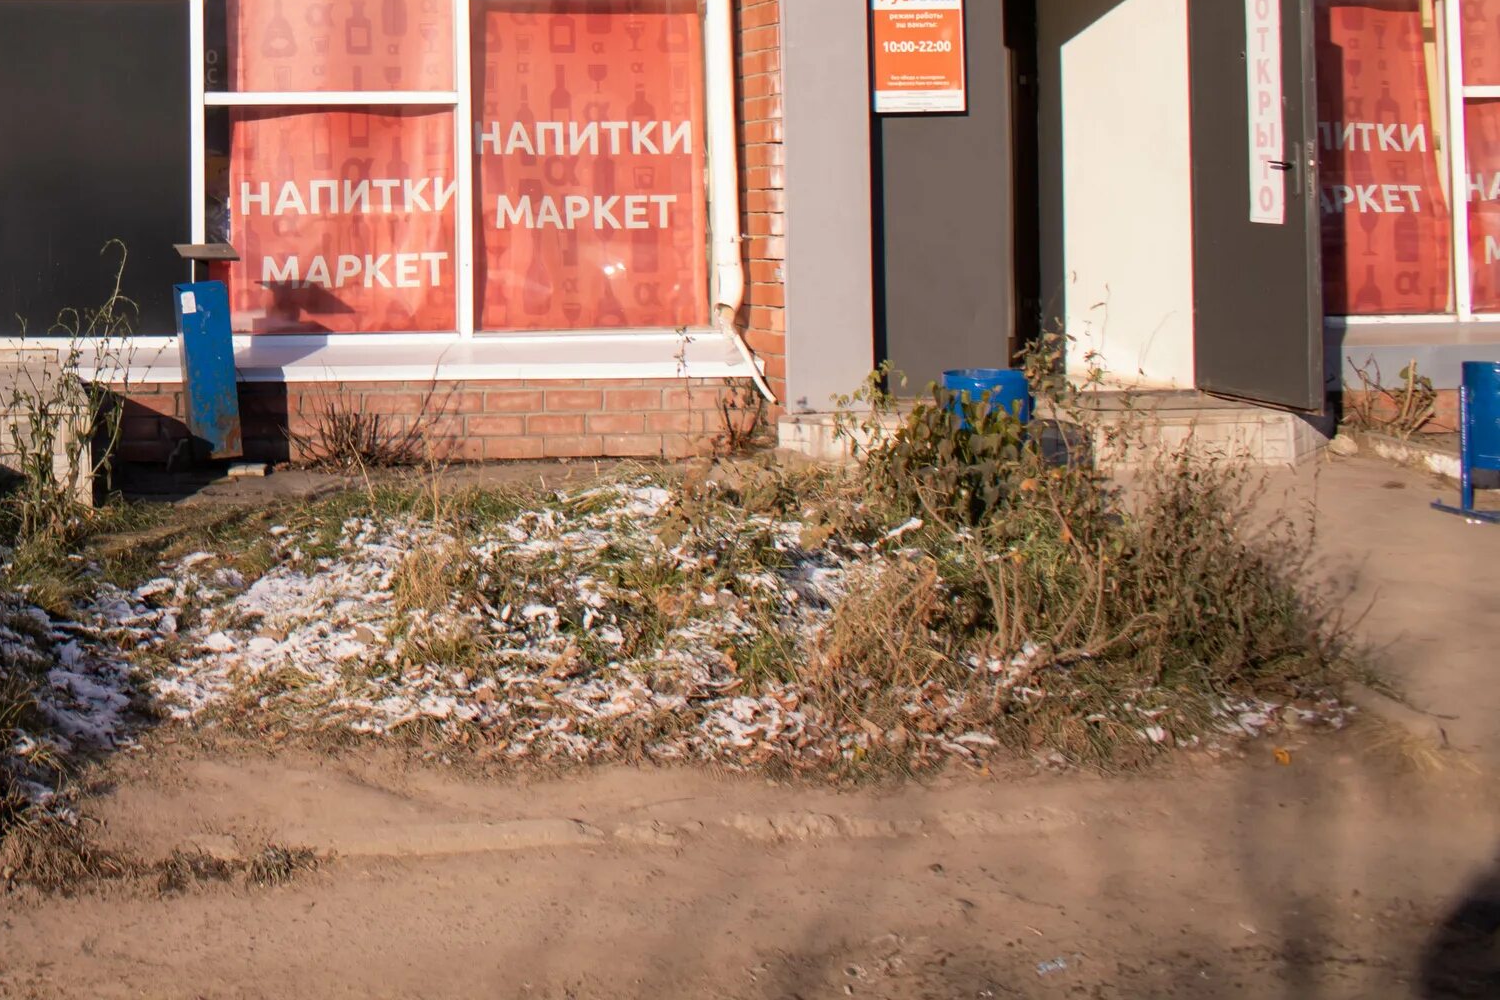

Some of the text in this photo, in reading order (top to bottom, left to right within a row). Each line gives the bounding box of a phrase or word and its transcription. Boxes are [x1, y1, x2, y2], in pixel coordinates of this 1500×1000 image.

[882, 40, 952, 53] 10:00-22:00
[474, 119, 693, 156] НАПИТКИ
[240, 176, 457, 216] НАПИТКИ
[495, 194, 677, 230] МАРКЕТ
[261, 251, 449, 290] МАРКЕТ
